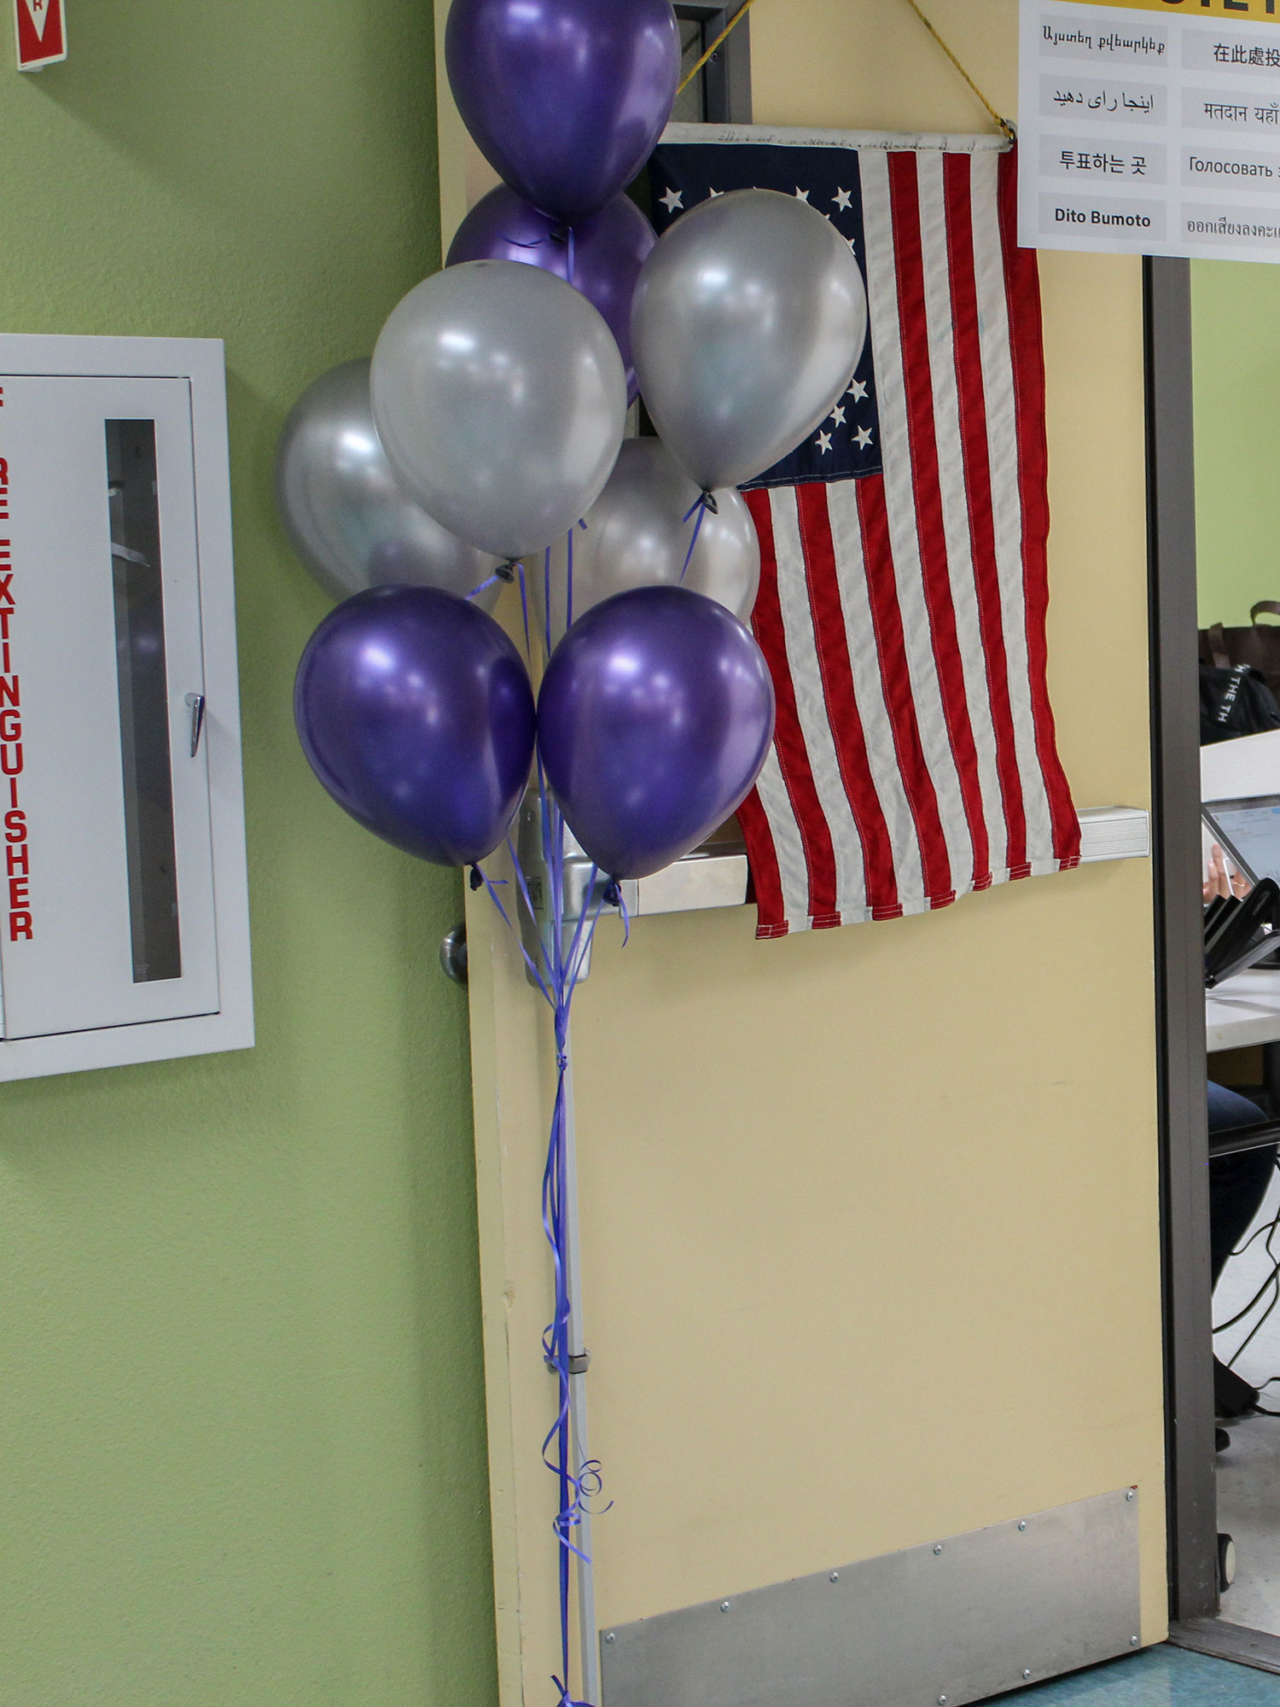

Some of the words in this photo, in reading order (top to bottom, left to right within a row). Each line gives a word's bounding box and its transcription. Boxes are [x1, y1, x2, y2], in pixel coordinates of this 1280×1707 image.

[1203, 102, 1248, 121] मतदान
[1060, 150, 1125, 173] 투표하는
[1131, 156, 1147, 175] 곳
[1189, 156, 1273, 178] Голосовать
[1055, 207, 1086, 223] Dito
[1091, 210, 1151, 227] Bumoto
